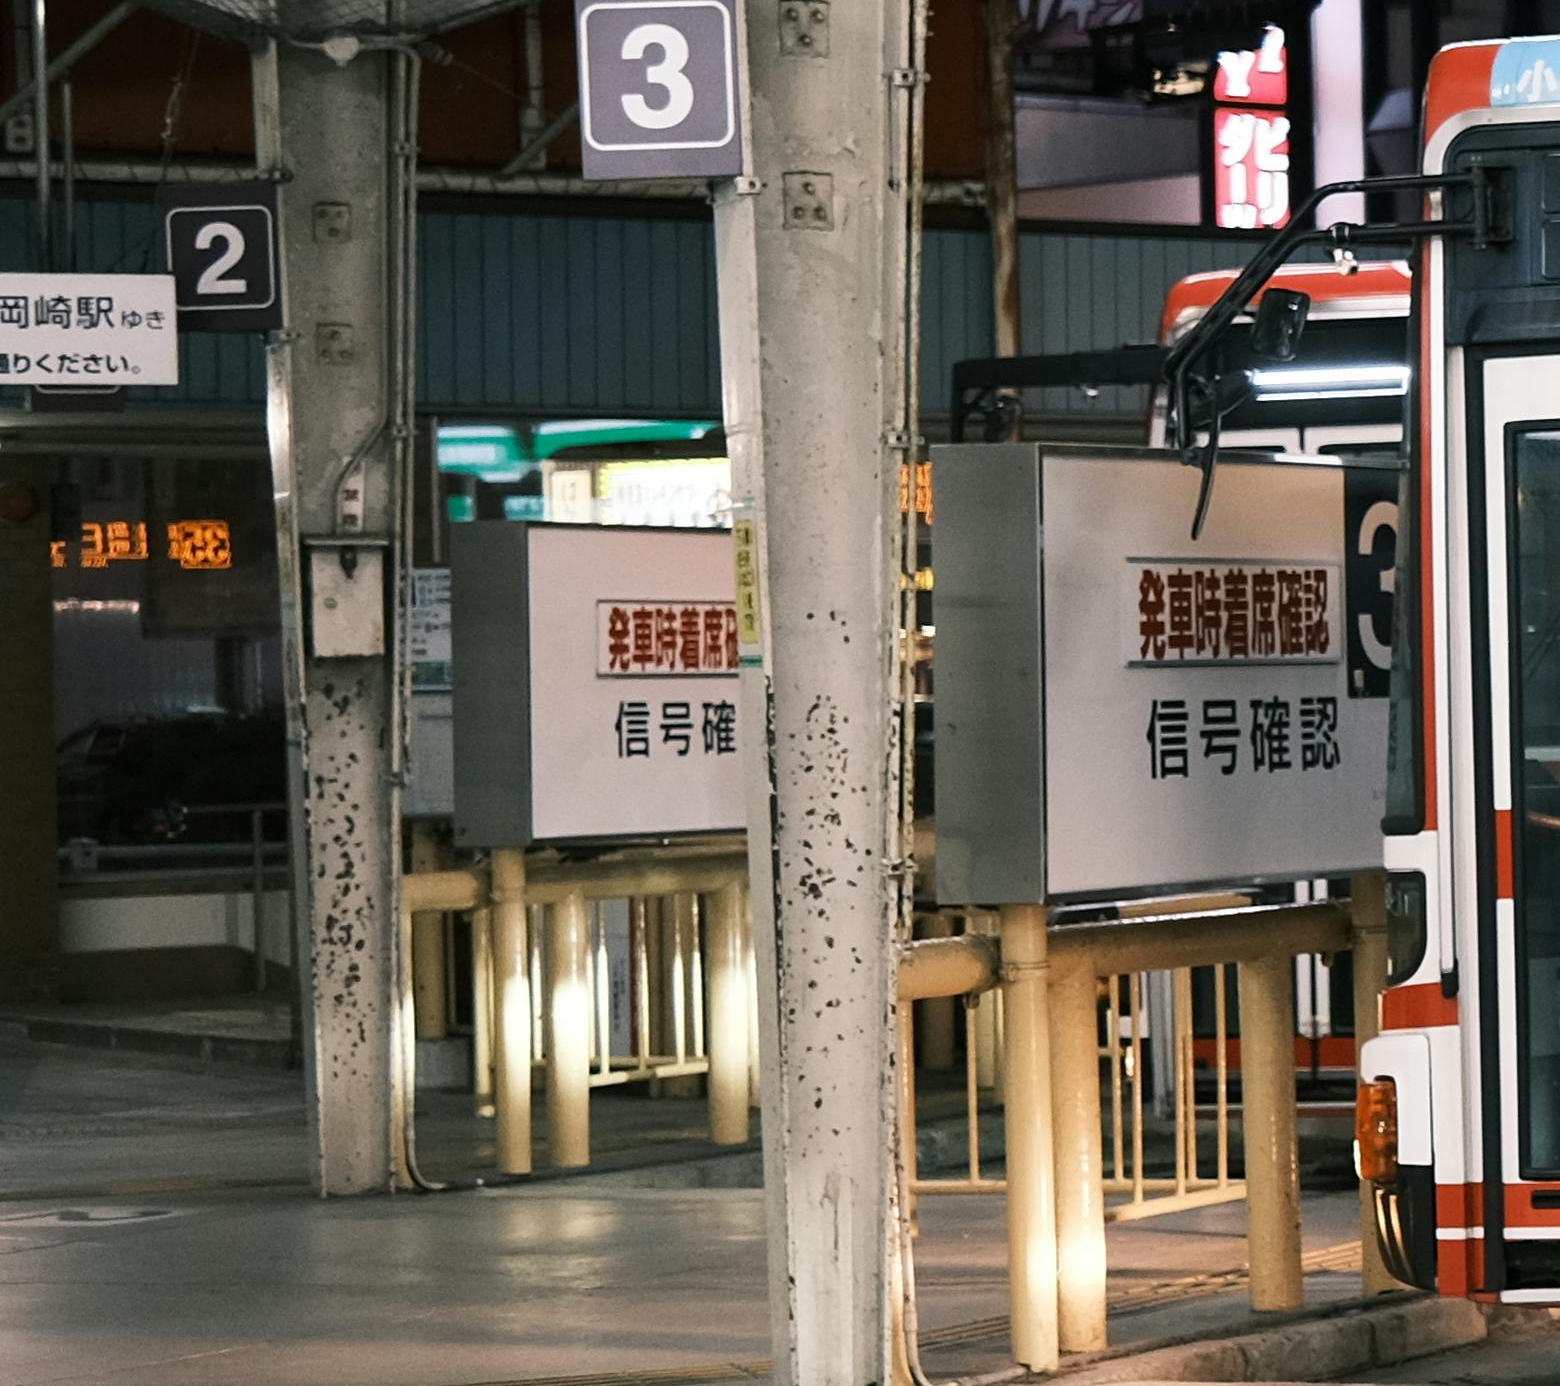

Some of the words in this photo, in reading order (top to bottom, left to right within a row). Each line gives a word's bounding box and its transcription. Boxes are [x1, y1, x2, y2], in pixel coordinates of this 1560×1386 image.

[621, 24, 694, 130] 3
[195, 221, 247, 294] 2
[1139, 568, 1330, 659] 発車時着席確認
[1358, 501, 1400, 670] 3
[1147, 696, 1341, 779] 信号確認
